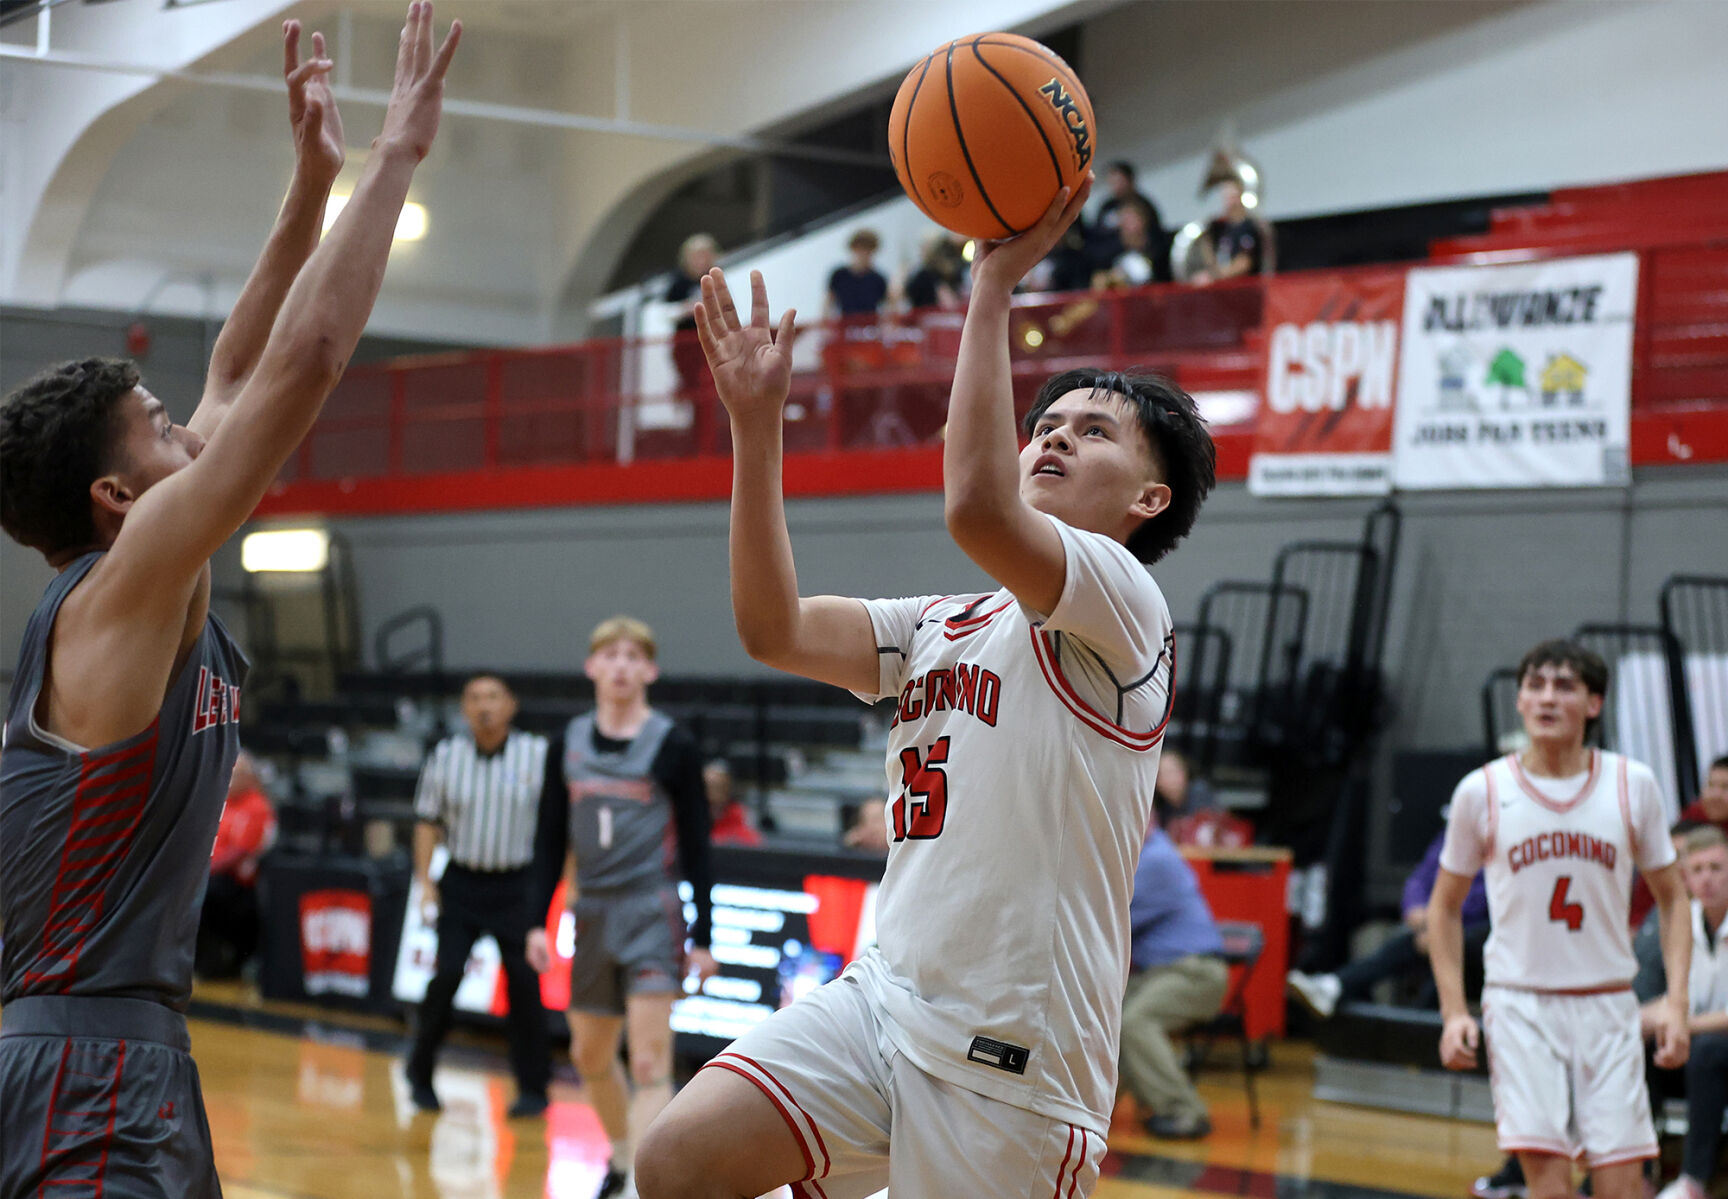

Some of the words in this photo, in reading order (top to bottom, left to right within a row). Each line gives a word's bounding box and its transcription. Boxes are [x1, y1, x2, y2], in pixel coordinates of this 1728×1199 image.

[1039, 77, 1091, 172] NCAA
[1268, 319, 1397, 414] CSPN
[597, 806, 613, 850] 1
[1549, 875, 1584, 932] 4
[1008, 1053, 1016, 1065] L
